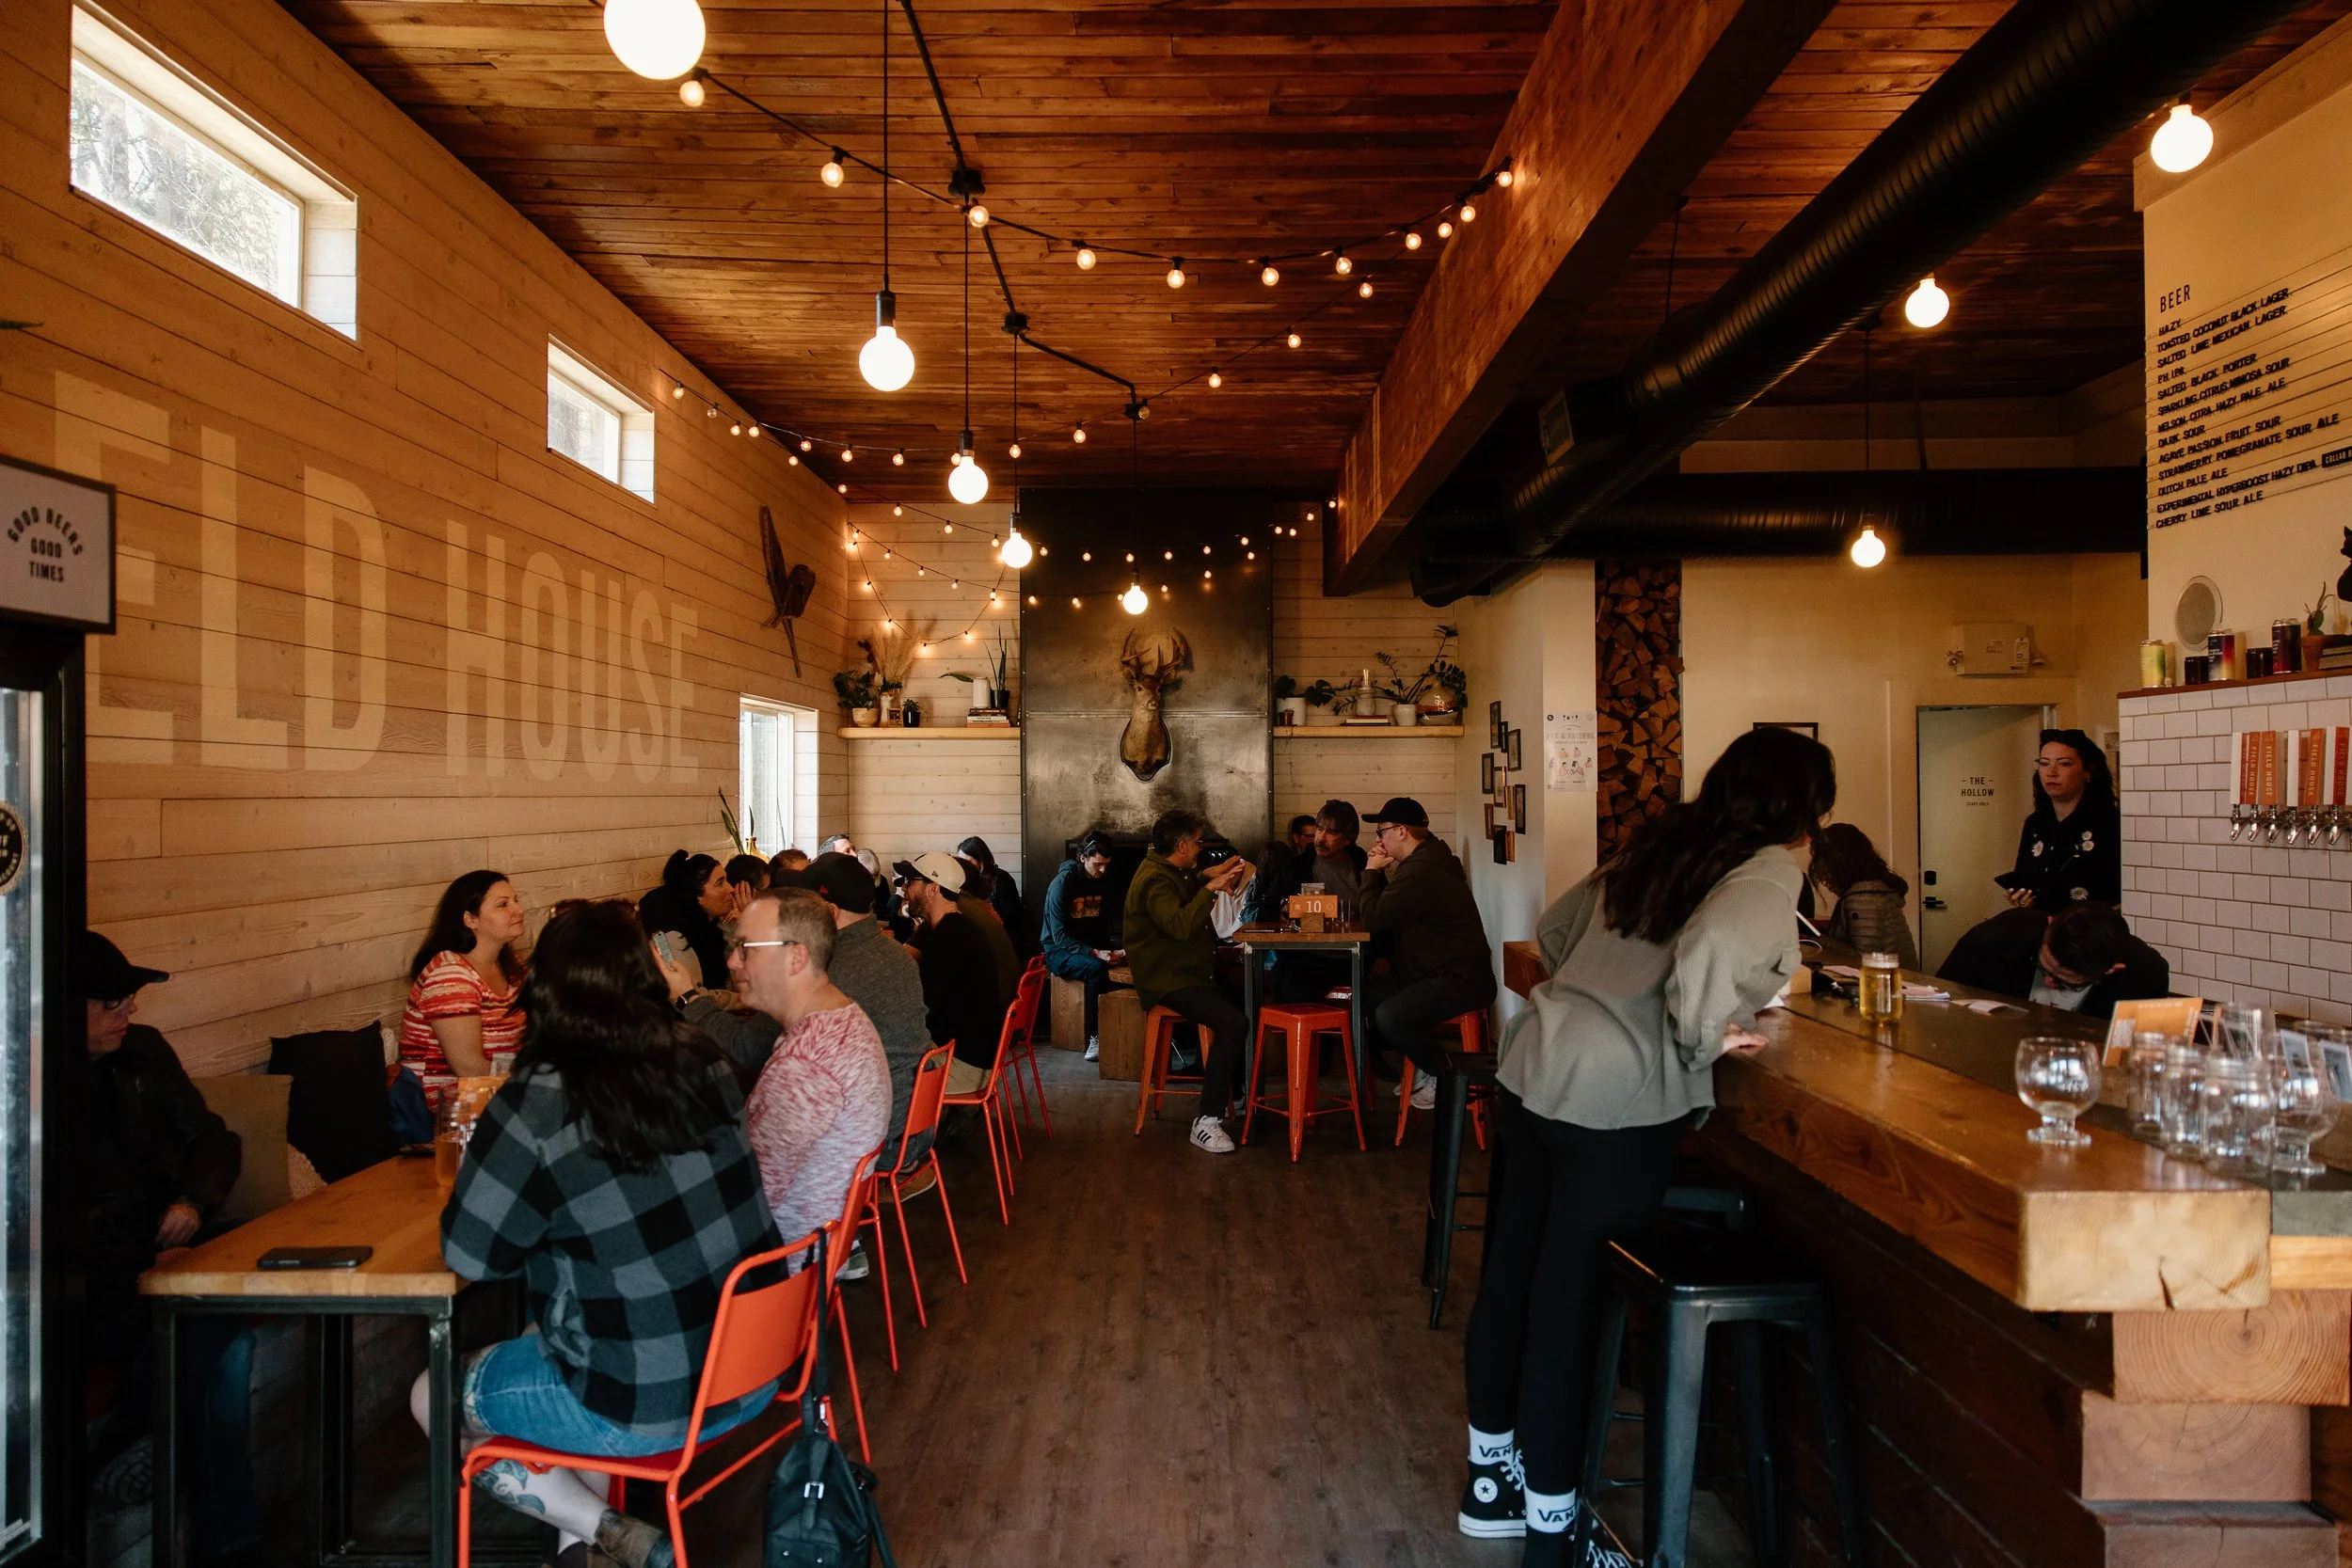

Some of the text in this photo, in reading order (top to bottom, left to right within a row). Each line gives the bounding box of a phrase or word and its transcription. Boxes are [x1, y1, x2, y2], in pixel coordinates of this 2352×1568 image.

[2160, 284, 2190, 313] BEER
[2156, 288, 2289, 353] TOASTED COCONUT BLACK LAGER
[2158, 319, 2181, 336] HAZY
[2157, 305, 2286, 368] SALTED LIME MEXICAN LAGER
[2157, 353, 2257, 400] SALTED BLACK PORTER
[2158, 357, 2290, 416] SPARKLING CITRUS MIMOSA SOUR
[2171, 366, 2185, 379] IPA
[2158, 377, 2286, 433] NELSON CITRA HAZY PALE ALE
[2158, 425, 2205, 448] DARK SOUR
[2158, 413, 2339, 481] STRAWBERRY POMEGRANATE SOUR ALE
[2159, 416, 2281, 463] AGAVE PASSION FRUIT SOUR
[2325, 451, 2346, 464] COLLAB
[2157, 459, 2317, 514] EXPERIMENTAL HYPERBOOST HAZY DIPA
[2158, 467, 2228, 497] DUTCH PALE ALE
[2155, 490, 2264, 529] CHERRY LIME SOUR ALE
[8, 506, 83, 556] GOOD BEERS
[30, 536, 62, 559] GOOD
[29, 560, 64, 582] TIMES
[446, 518, 700, 784] HOUSE
[1961, 788, 1994, 797] HOLLOW
[1969, 776, 1985, 785] THE
[2308, 770, 2316, 796] HOUSE
[1306, 900, 1322, 913] 10
[1479, 1443, 1513, 1459] VAN
[1538, 1505, 1576, 1523] VAN
